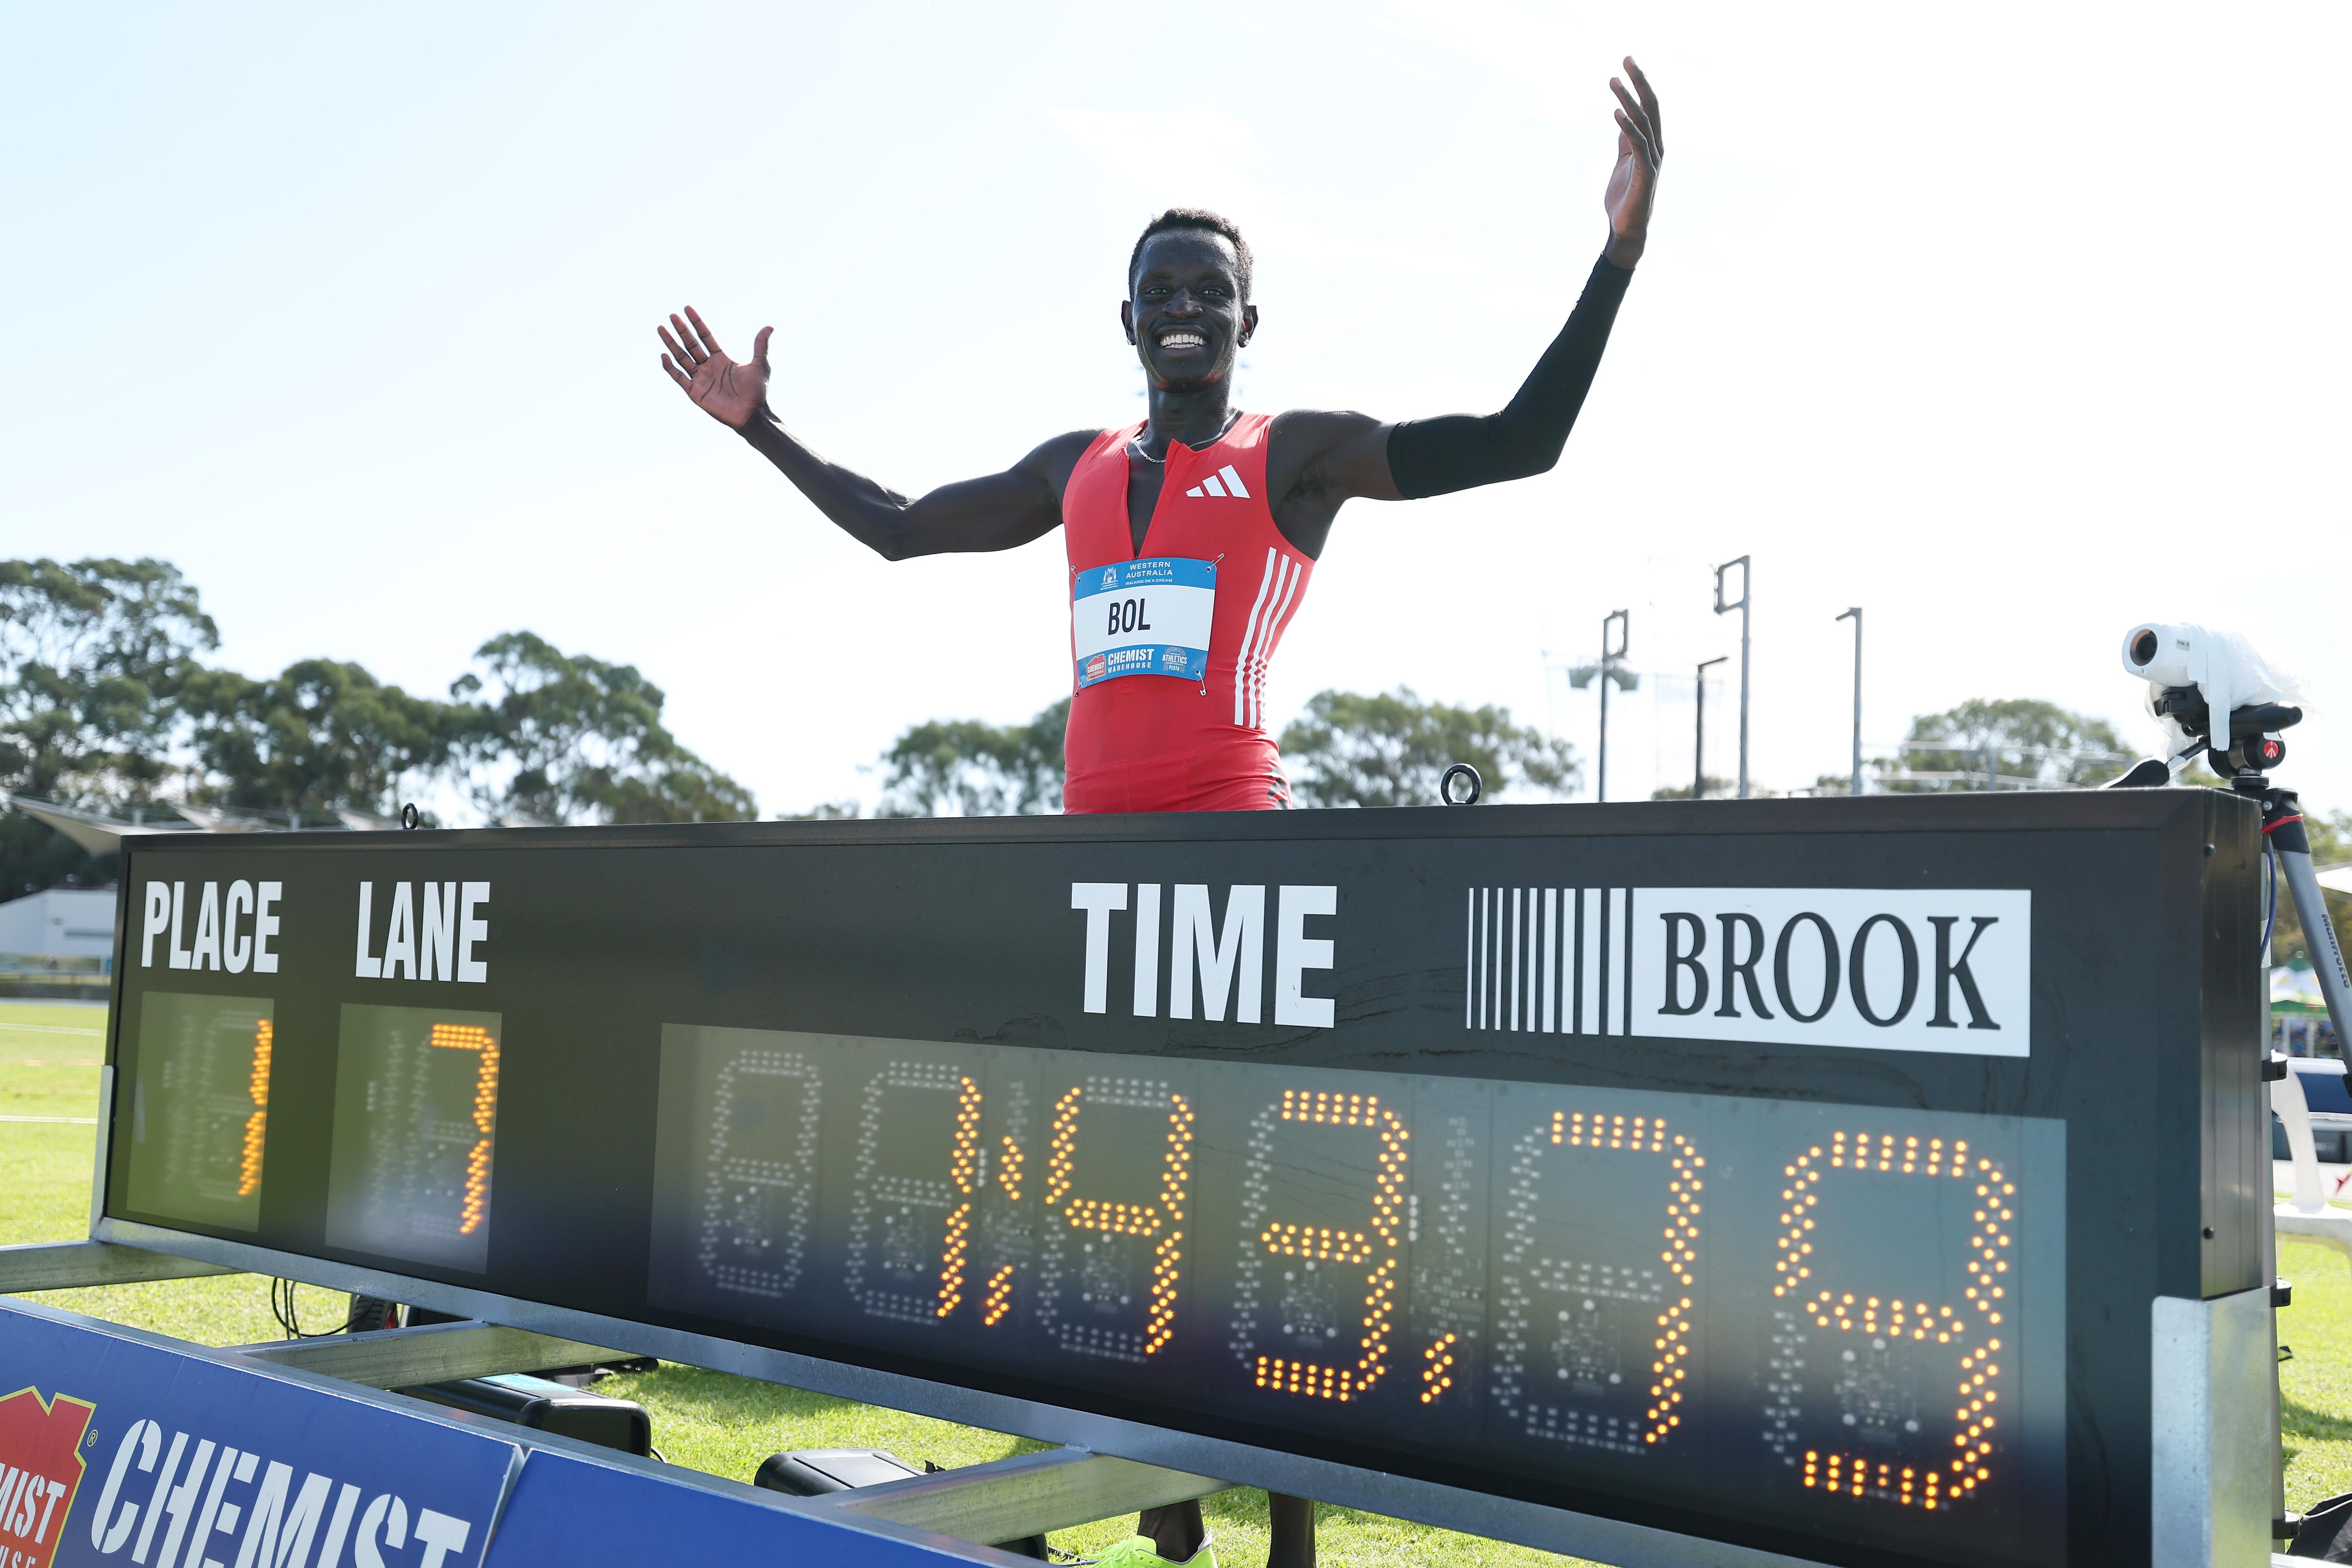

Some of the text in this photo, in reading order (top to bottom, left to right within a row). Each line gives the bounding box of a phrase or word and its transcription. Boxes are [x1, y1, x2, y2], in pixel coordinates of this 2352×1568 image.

[1126, 570, 1173, 579] AUSTRALIA
[1130, 562, 1170, 570] WESTERN
[1108, 598, 1151, 636] BOL
[1088, 662, 1104, 673] CHEMIST
[1108, 649, 1154, 666] CHEMIST
[1108, 662, 1151, 673] WAREHOUSE
[1162, 654, 1188, 664] ATHLETICS
[141, 879, 282, 974] PLACE
[355, 881, 490, 983] LANE
[1071, 882, 1337, 1028] TIME
[1657, 911, 2002, 1032] BROOK
[237, 1019, 273, 1196] 1
[430, 1023, 500, 1234] 7
